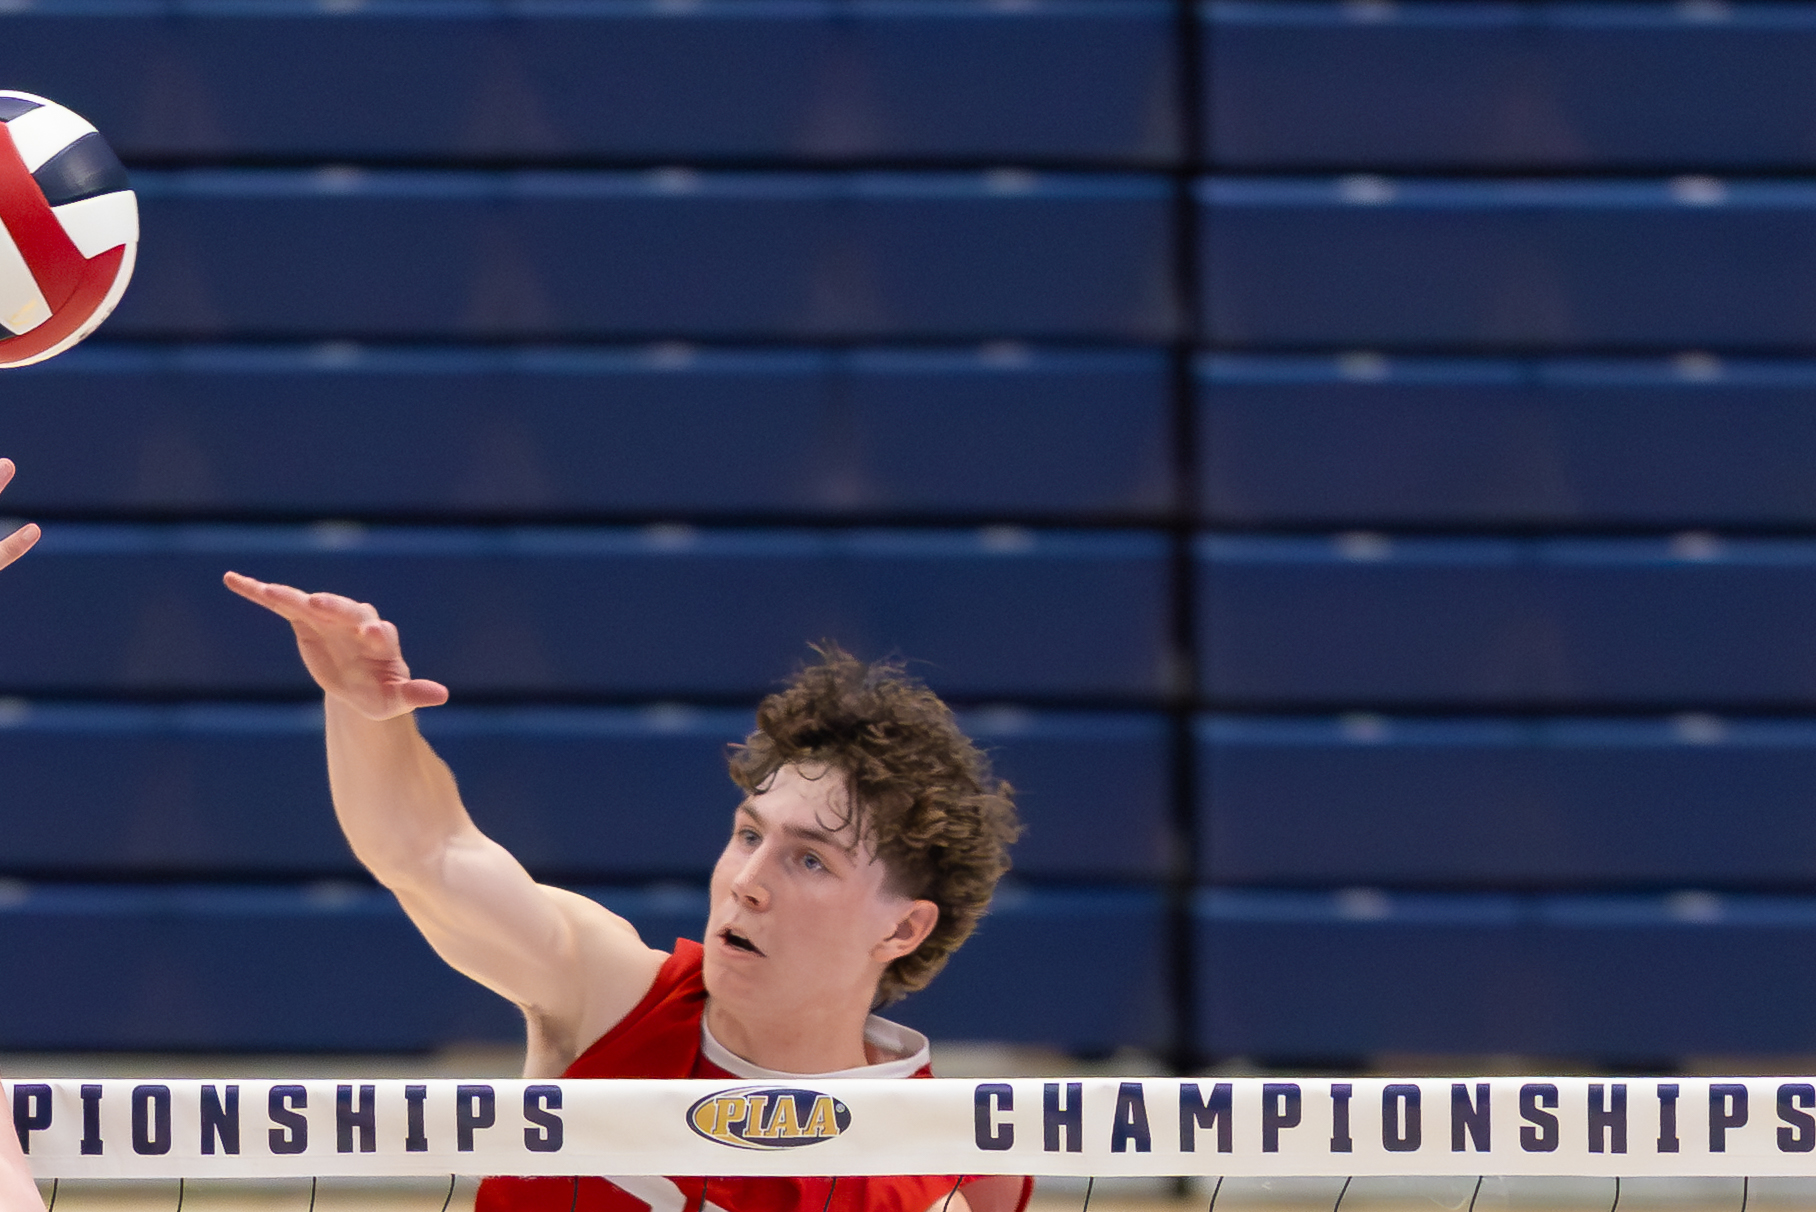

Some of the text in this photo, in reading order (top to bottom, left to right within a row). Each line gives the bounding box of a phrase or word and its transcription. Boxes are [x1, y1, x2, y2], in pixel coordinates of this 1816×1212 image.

[13, 1084, 564, 1155] PIONSHIPS
[711, 1083, 1816, 1154] PIAA CHAMPIONSHIPS
